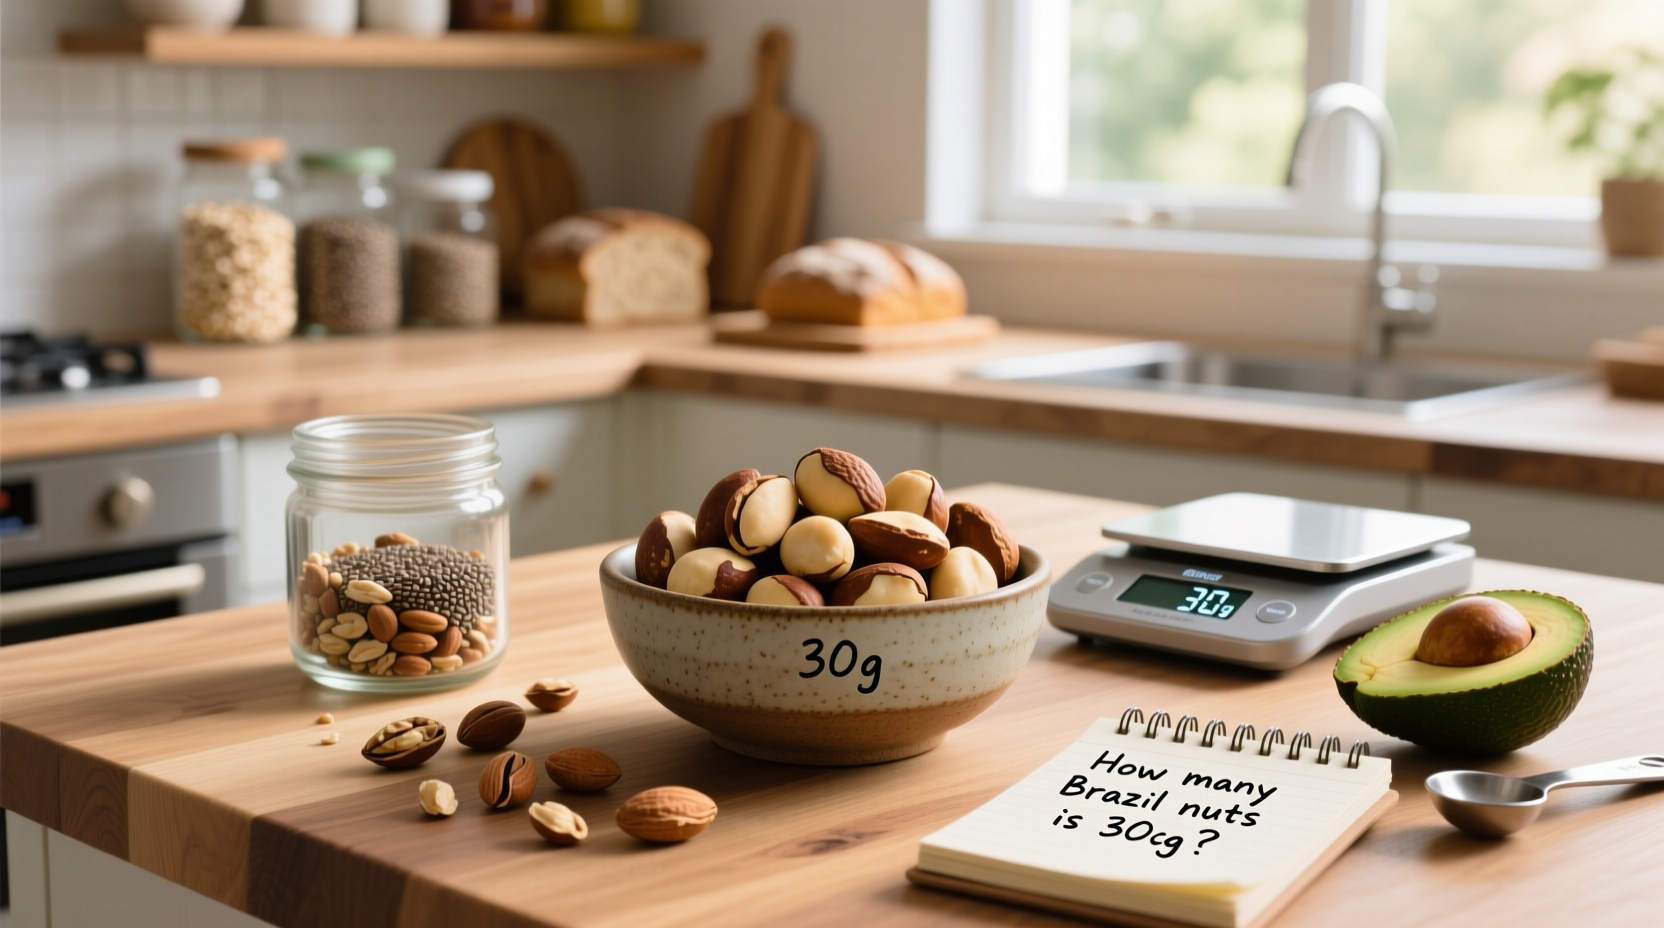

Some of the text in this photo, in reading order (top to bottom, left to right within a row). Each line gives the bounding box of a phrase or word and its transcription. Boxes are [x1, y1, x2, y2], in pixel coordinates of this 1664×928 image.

[1177, 586, 1235, 619] 30g
[799, 638, 882, 694] 30g
[1059, 774, 1260, 827] Brazil nuts
[1090, 750, 1277, 806] How many
[1052, 808, 1083, 829] is
